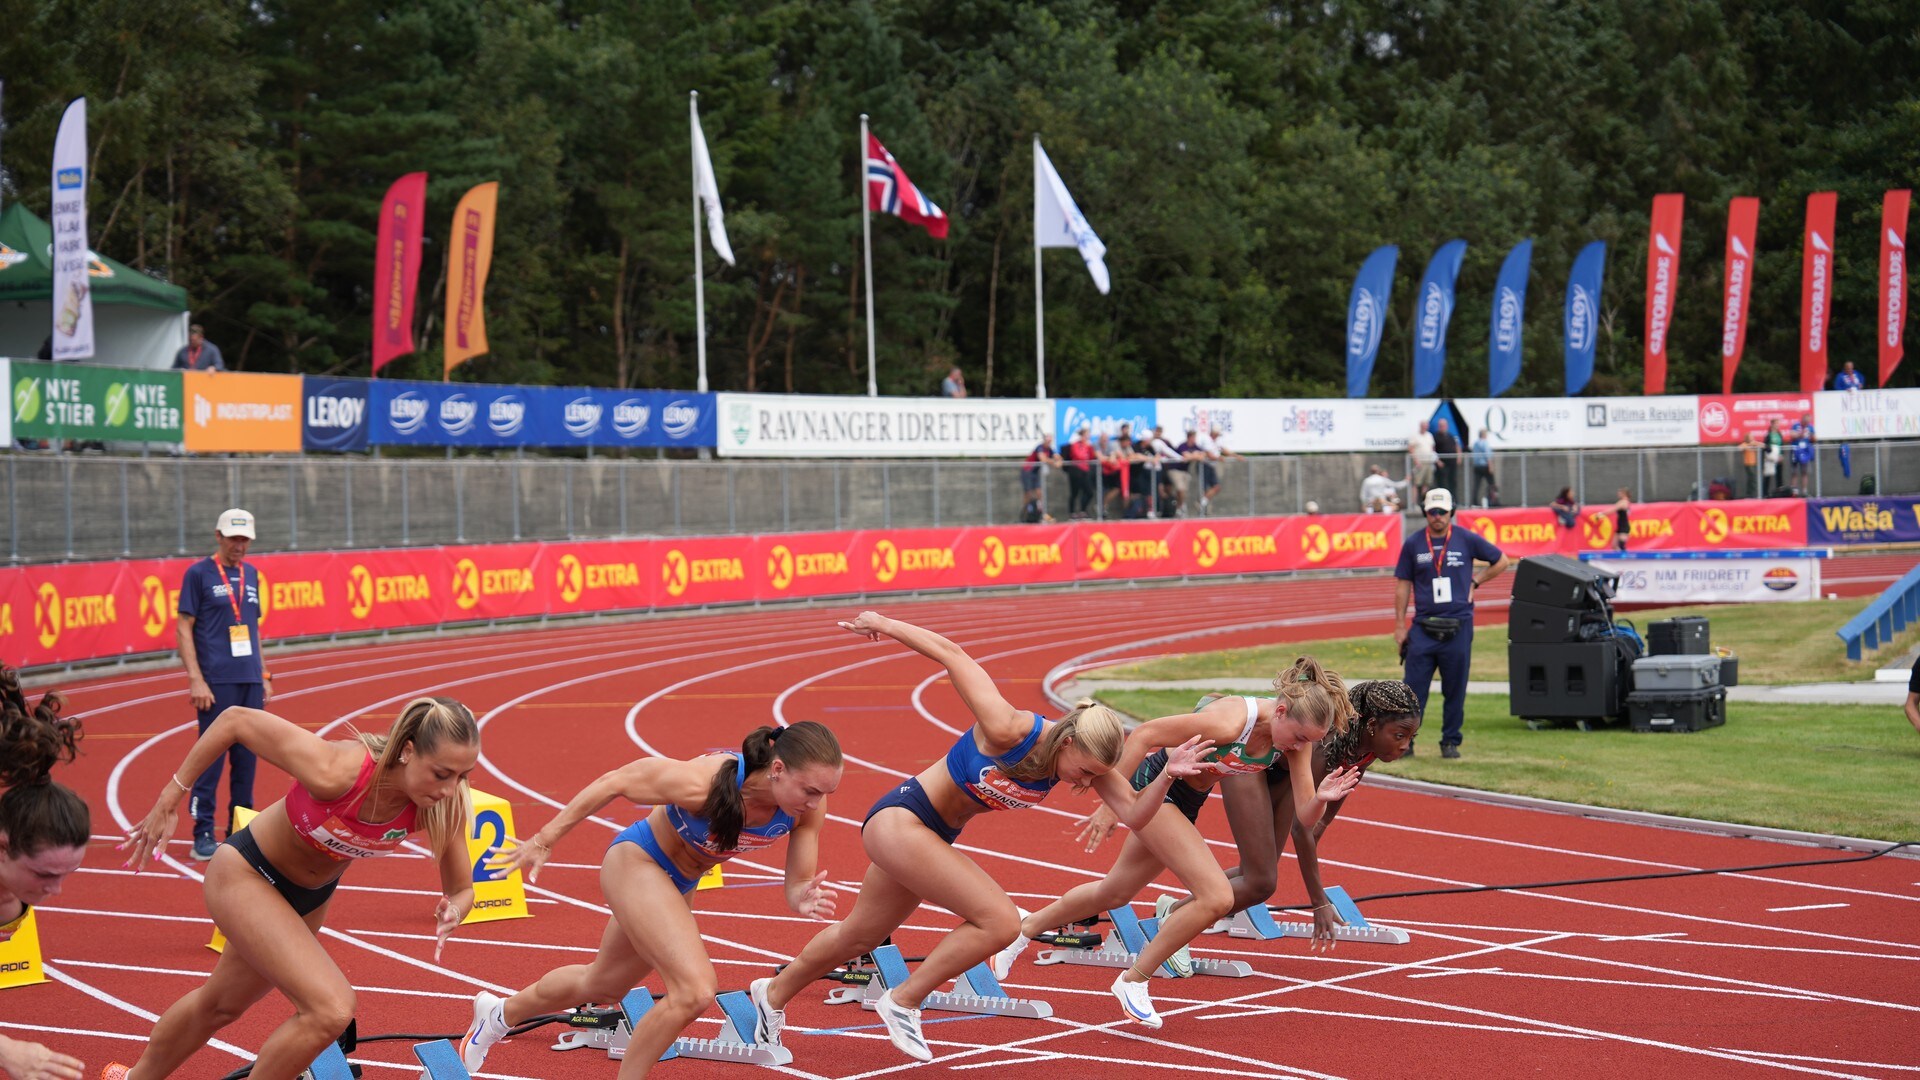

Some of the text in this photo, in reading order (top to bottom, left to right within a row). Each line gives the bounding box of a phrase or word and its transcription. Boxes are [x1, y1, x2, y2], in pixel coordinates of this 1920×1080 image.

[1650, 257, 1671, 355] GATORADE
[1722, 259, 1745, 357] GATORADE
[1809, 254, 1827, 352] GATORADE
[1887, 251, 1902, 347] GATORADE
[46, 378, 81, 402] NYE
[134, 384, 167, 407] NYE
[46, 402, 95, 426] STIER
[134, 406, 180, 429] STIER
[308, 396, 365, 428] LERØY
[1512, 409, 1570, 420] QUALIFIED
[1611, 406, 1646, 421] Ultima
[1649, 406, 1694, 423] Revisjon
[1895, 414, 1920, 433] BAR
[759, 410, 892, 441] RAVNANGER
[898, 411, 1046, 442] IDRETTSPARK
[1513, 421, 1554, 432] PEOPLE
[1629, 519, 1674, 538] XTRA
[1733, 515, 1791, 533] EXTRA
[1821, 504, 1895, 532] Wasa
[1332, 531, 1388, 551] EXTRA
[1501, 522, 1556, 543] EXTRA
[1008, 543, 1062, 565] EXTRA
[1116, 540, 1170, 560] EXTRA
[1222, 535, 1277, 556] EXTRA
[690, 558, 744, 583] EXTRA
[796, 552, 849, 576] EXTRA
[901, 548, 955, 571] EXTRA
[482, 568, 535, 595] EXTRA
[585, 562, 640, 588] EXTRA
[1655, 567, 1751, 581] NM FRIIDRETT
[272, 580, 326, 610] EXTRA
[375, 574, 431, 603] EXTRA
[64, 594, 117, 629] EXTRA
[324, 838, 374, 858] MEDIC
[473, 809, 507, 883] 2
[472, 898, 512, 909] NORDIC
[0, 960, 30, 973] RDIC
